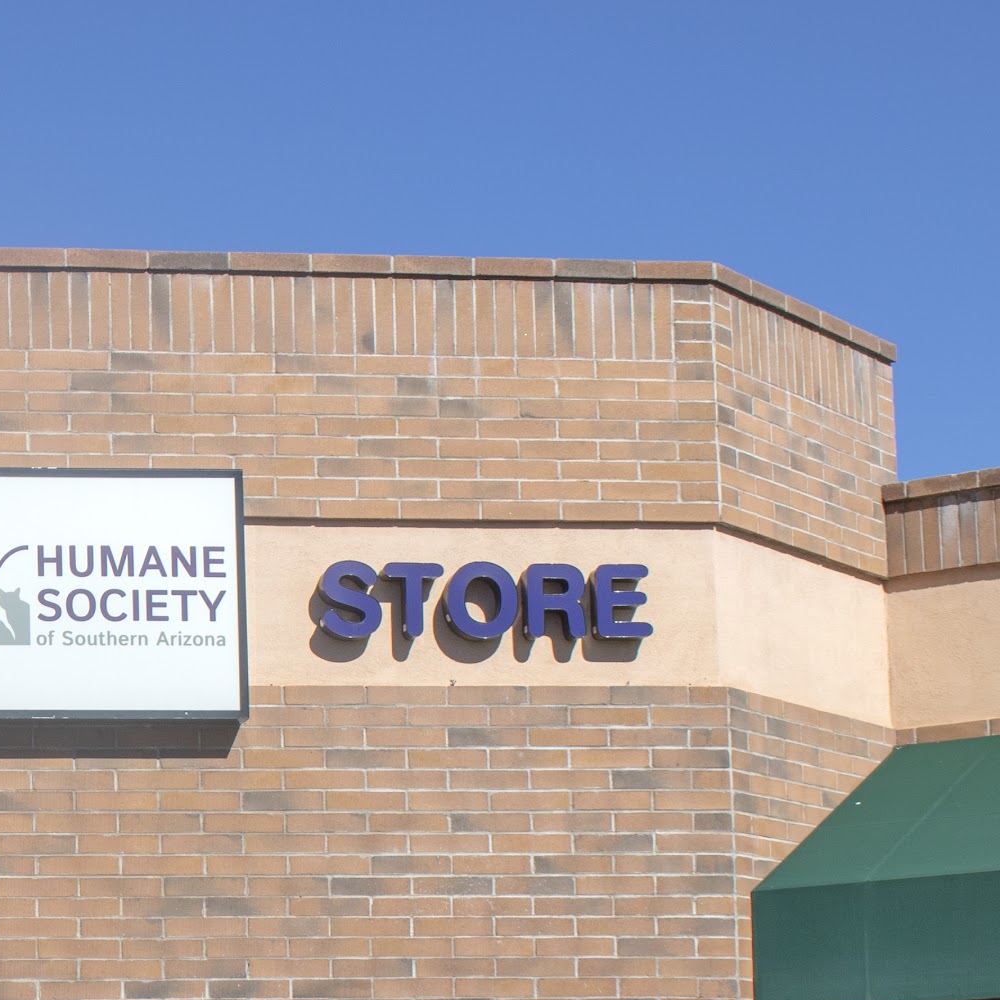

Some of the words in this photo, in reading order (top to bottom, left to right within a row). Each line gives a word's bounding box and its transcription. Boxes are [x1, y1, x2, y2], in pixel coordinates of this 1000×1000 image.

[36, 545, 226, 577] HUMANE
[36, 588, 226, 622] SOCIETY
[321, 560, 653, 638] STORE
[36, 630, 55, 646] of
[62, 630, 148, 647] Southern
[156, 631, 226, 647] Arizona
